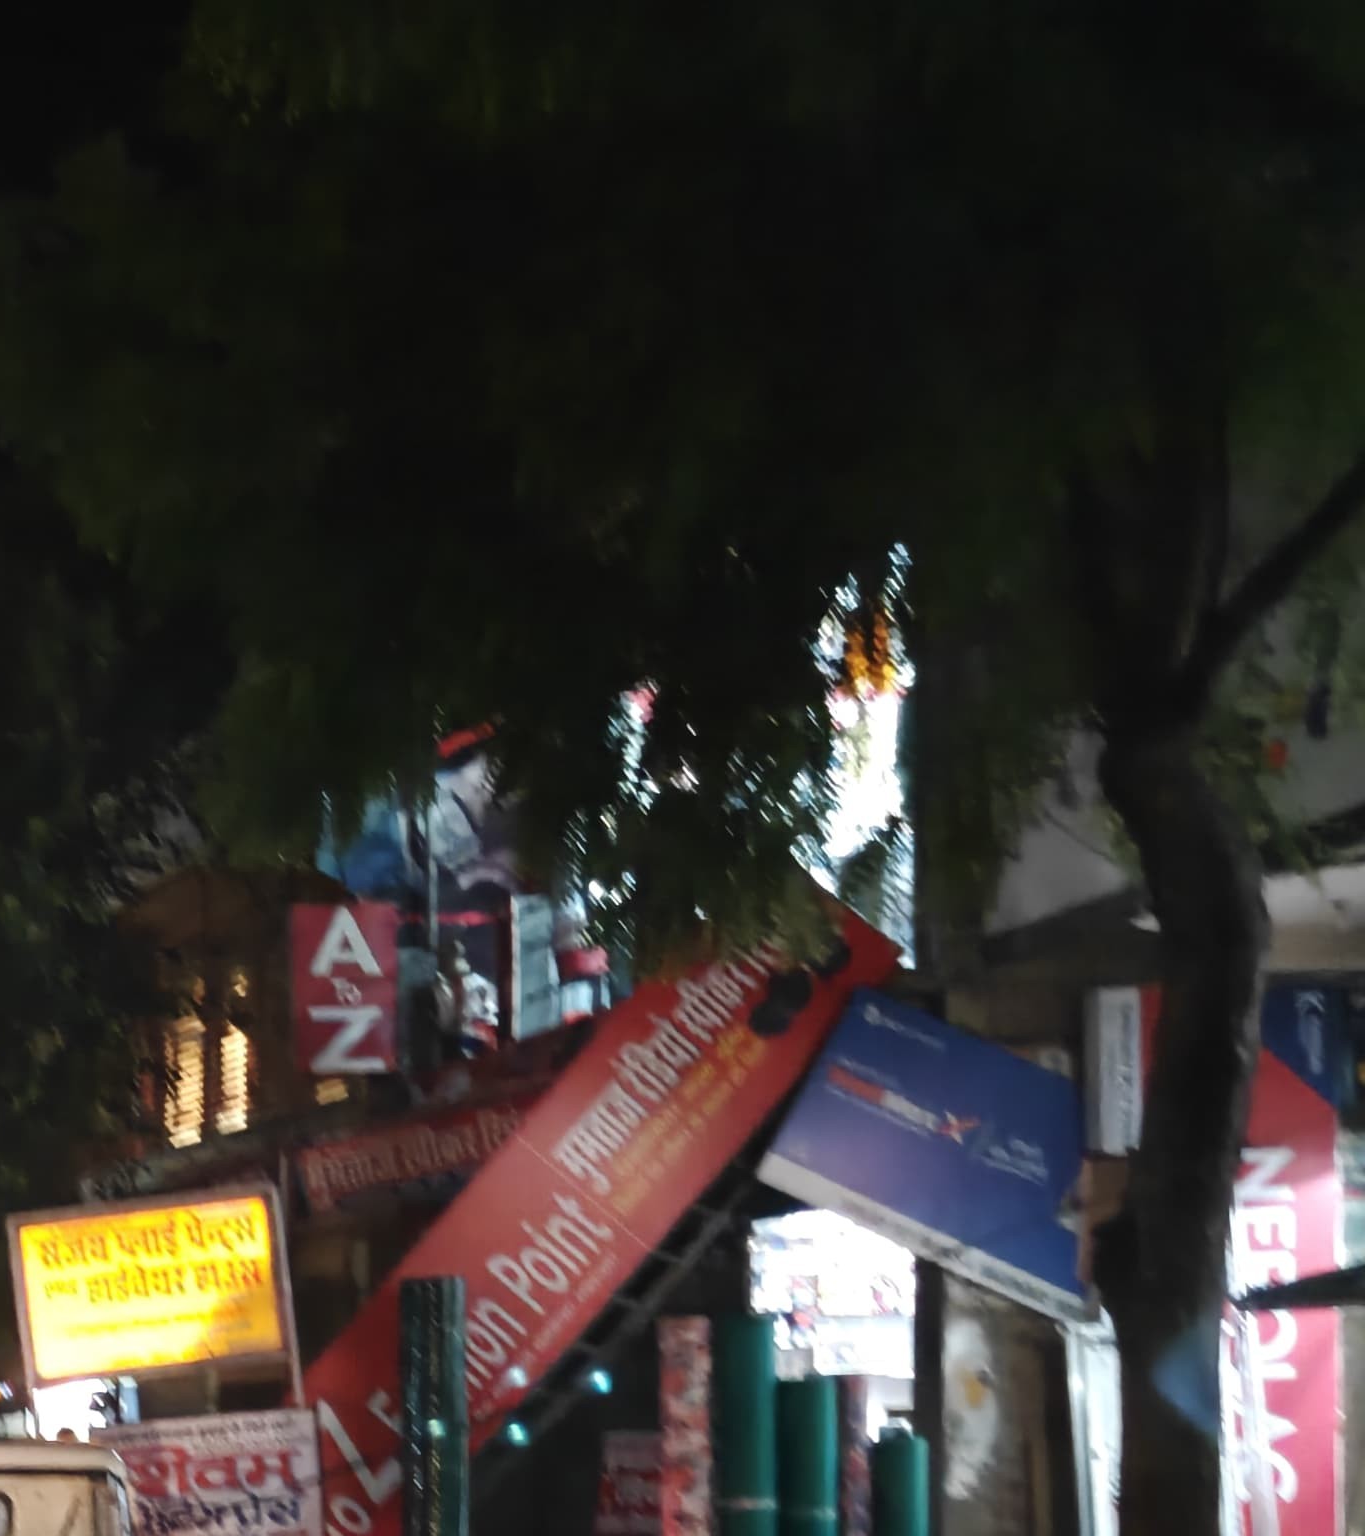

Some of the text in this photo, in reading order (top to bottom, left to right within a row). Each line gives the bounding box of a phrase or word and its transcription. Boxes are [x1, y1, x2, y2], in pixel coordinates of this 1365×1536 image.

[310, 906, 384, 977] A
[307, 1004, 387, 1074] Z
[484, 1192, 614, 1316] Point
